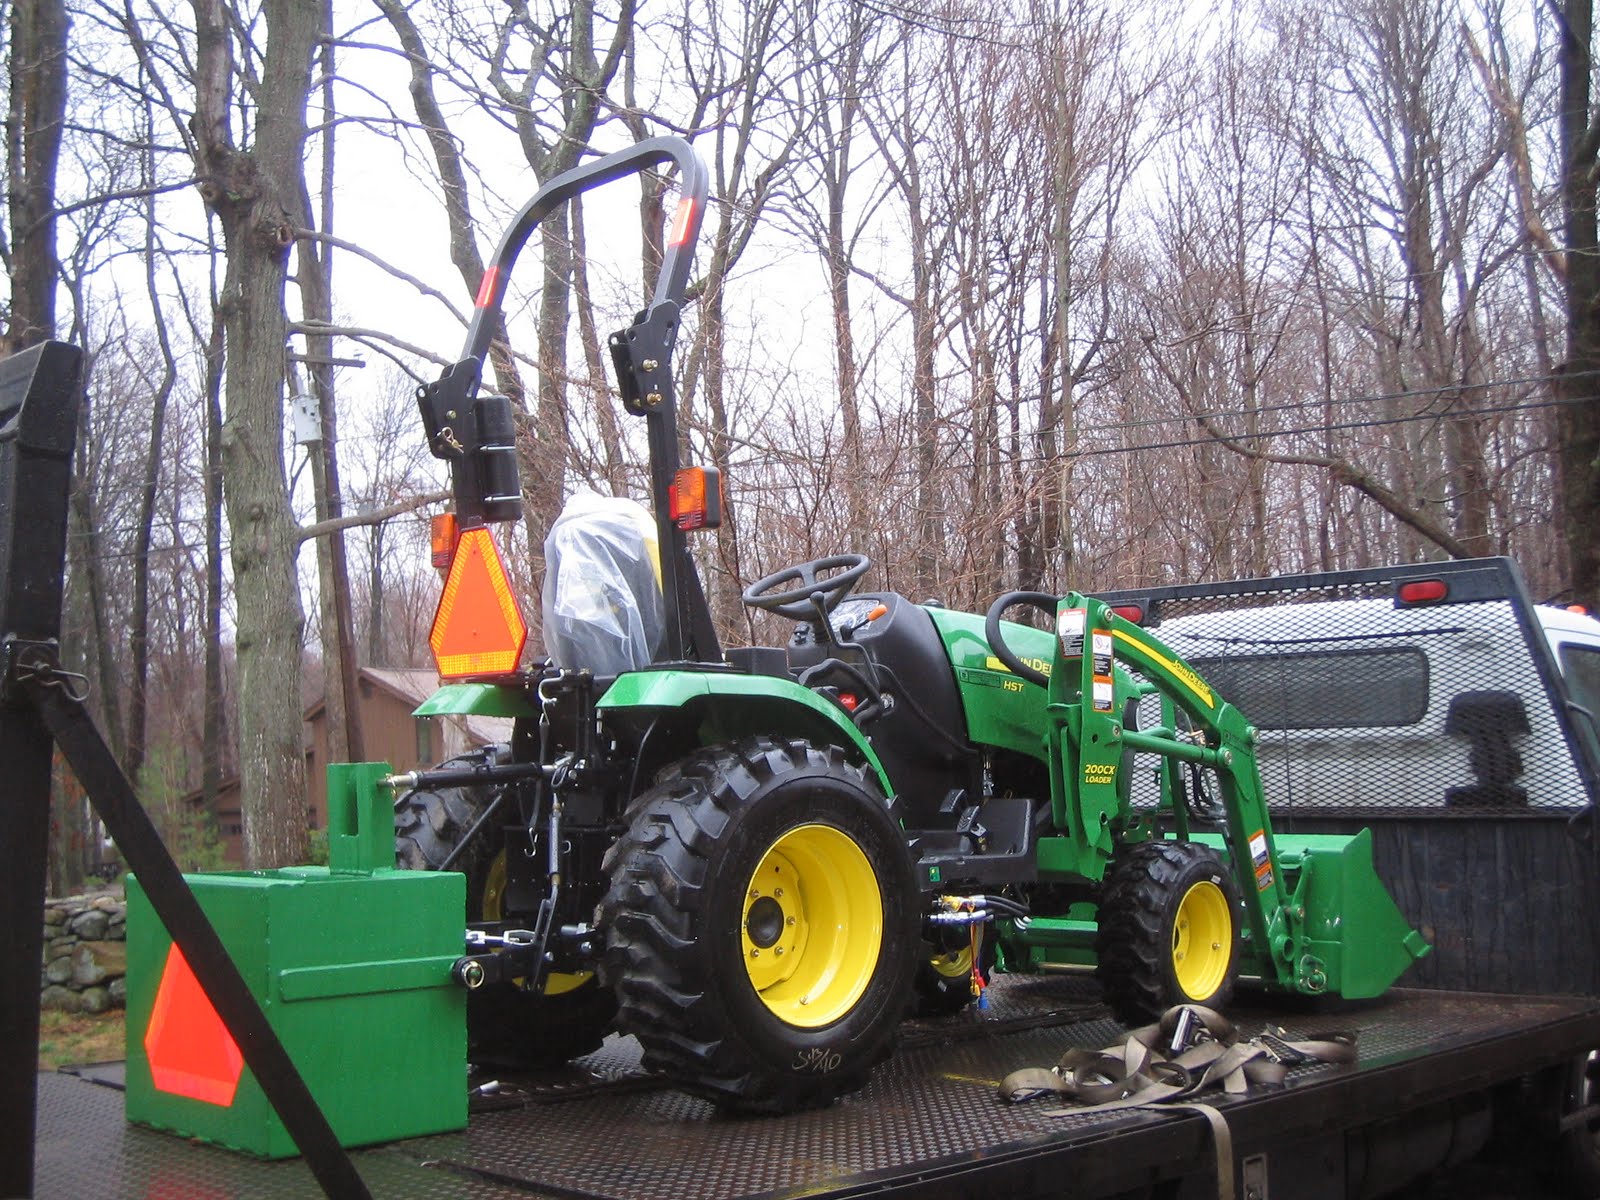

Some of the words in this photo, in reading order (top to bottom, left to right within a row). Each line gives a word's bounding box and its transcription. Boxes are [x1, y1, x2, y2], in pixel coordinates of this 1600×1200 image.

[1003, 680, 1024, 692] HST
[1084, 764, 1116, 775] 200CX
[1085, 775, 1112, 784] LOADER
